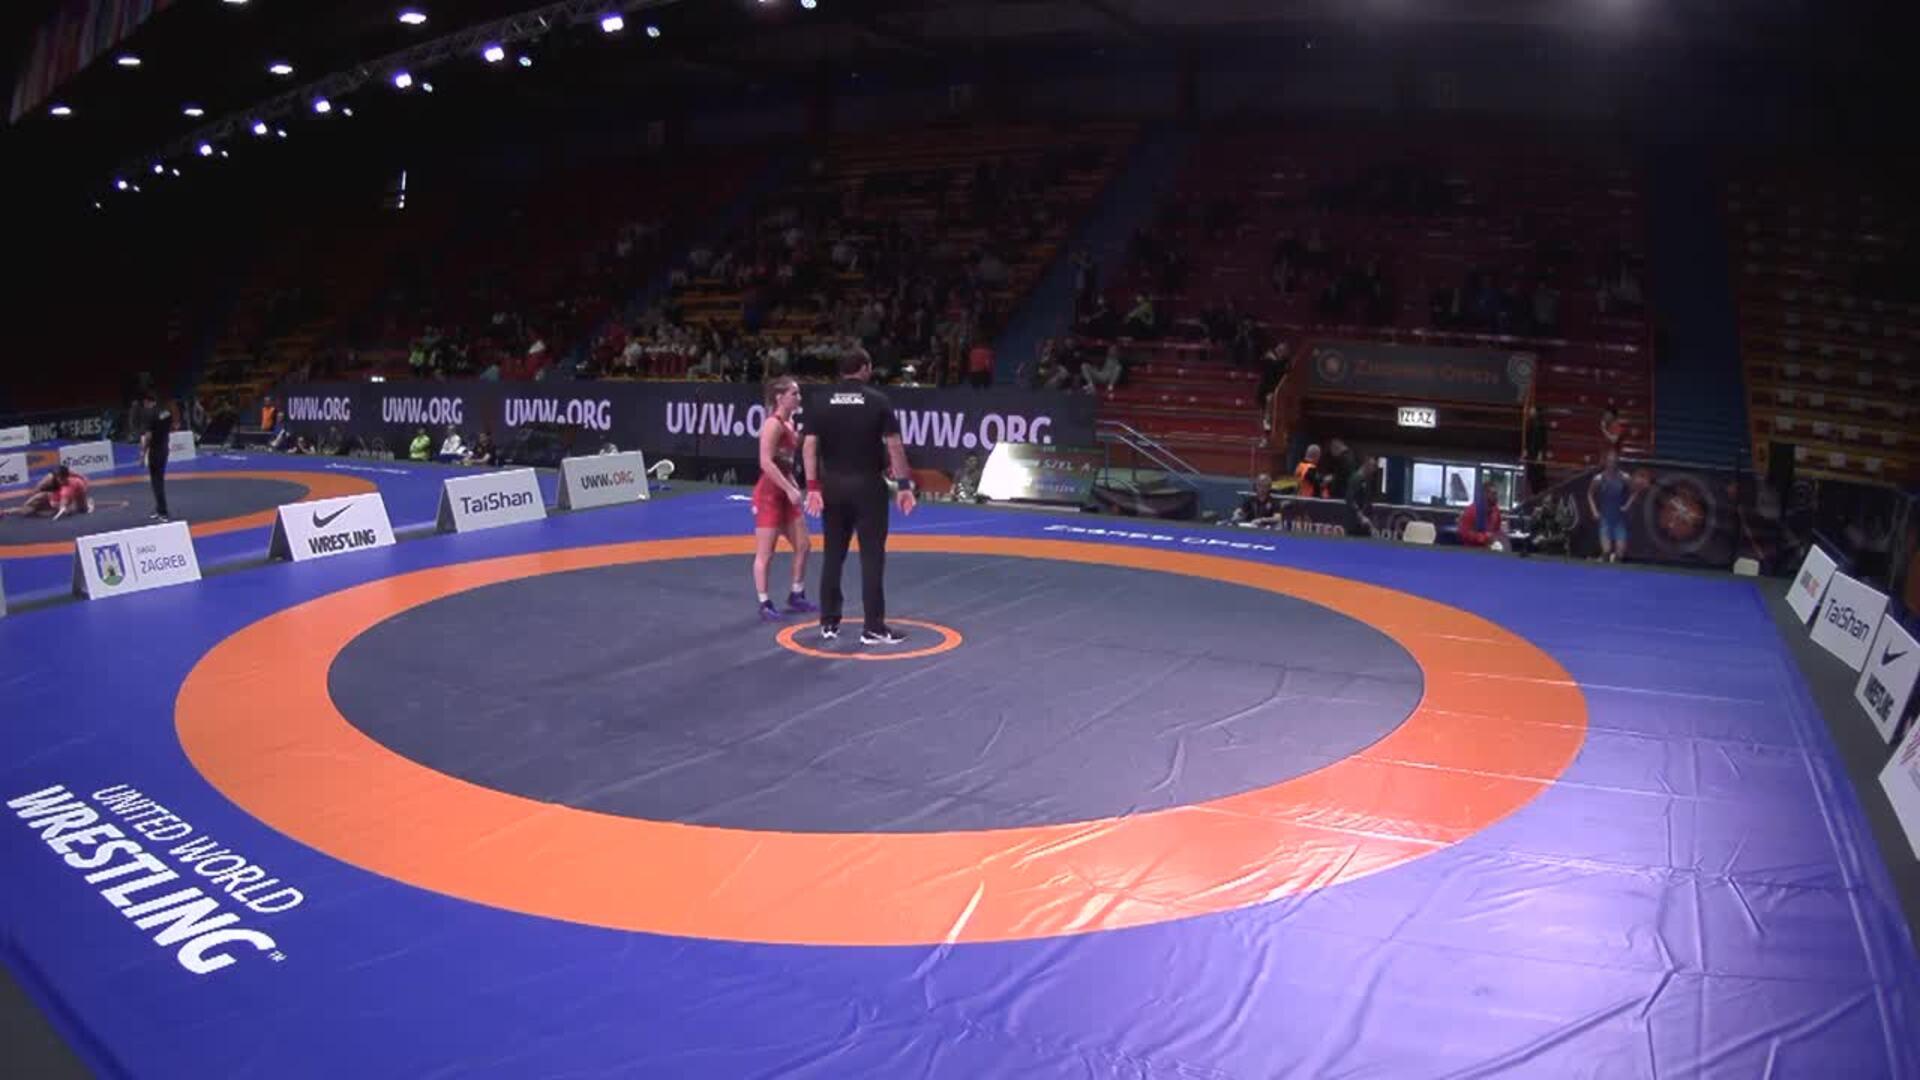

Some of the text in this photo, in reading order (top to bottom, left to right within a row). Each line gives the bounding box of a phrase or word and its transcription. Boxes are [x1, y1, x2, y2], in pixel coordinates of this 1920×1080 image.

[288, 396, 350, 421] UWW.ORG
[382, 397, 463, 424] UWW.ORG
[505, 398, 612, 431] UWW.ORG
[666, 402, 804, 438] UWW.O
[894, 408, 1052, 450] WW.ORG
[580, 470, 635, 489] UWW.ORG
[460, 488, 533, 515] TaiShan
[308, 529, 376, 555] WRESTLING
[140, 554, 186, 574] ZAGREB
[1825, 598, 1870, 642] TaiShan
[92, 784, 304, 914] UNITED WORLD
[6, 784, 277, 974] WRESTLING
